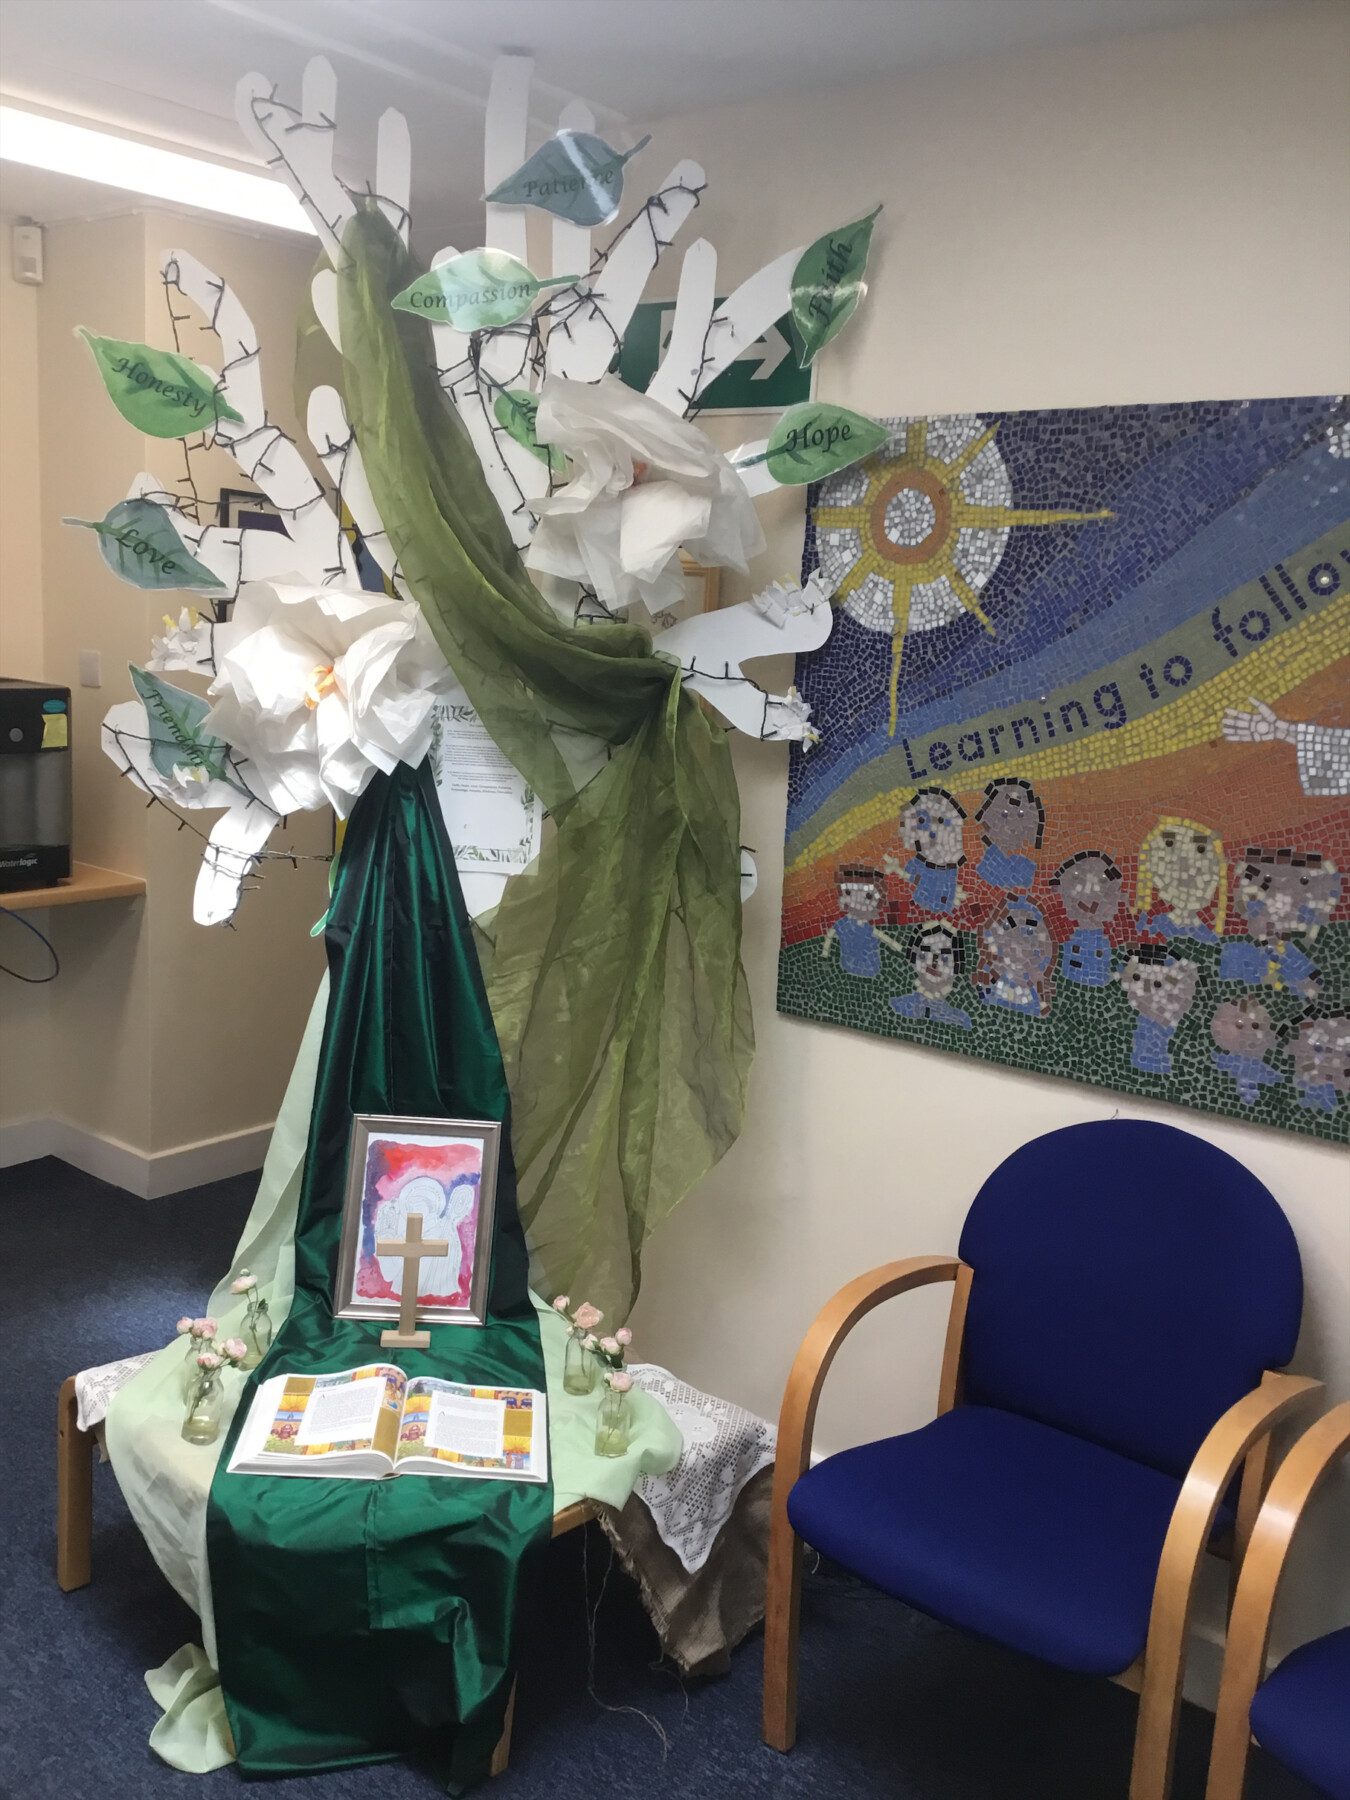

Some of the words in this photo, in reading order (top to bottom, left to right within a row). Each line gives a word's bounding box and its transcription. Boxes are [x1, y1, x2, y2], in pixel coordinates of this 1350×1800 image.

[523, 169, 614, 197] Patiece
[410, 283, 531, 313] Compassion
[111, 357, 207, 418] Honesty
[785, 421, 853, 453] Hope
[115, 528, 176, 575] Love
[902, 681, 1128, 780] Learning
[1139, 655, 1193, 700] to
[1211, 549, 1350, 658] follo
[140, 689, 204, 768] Friendshi
